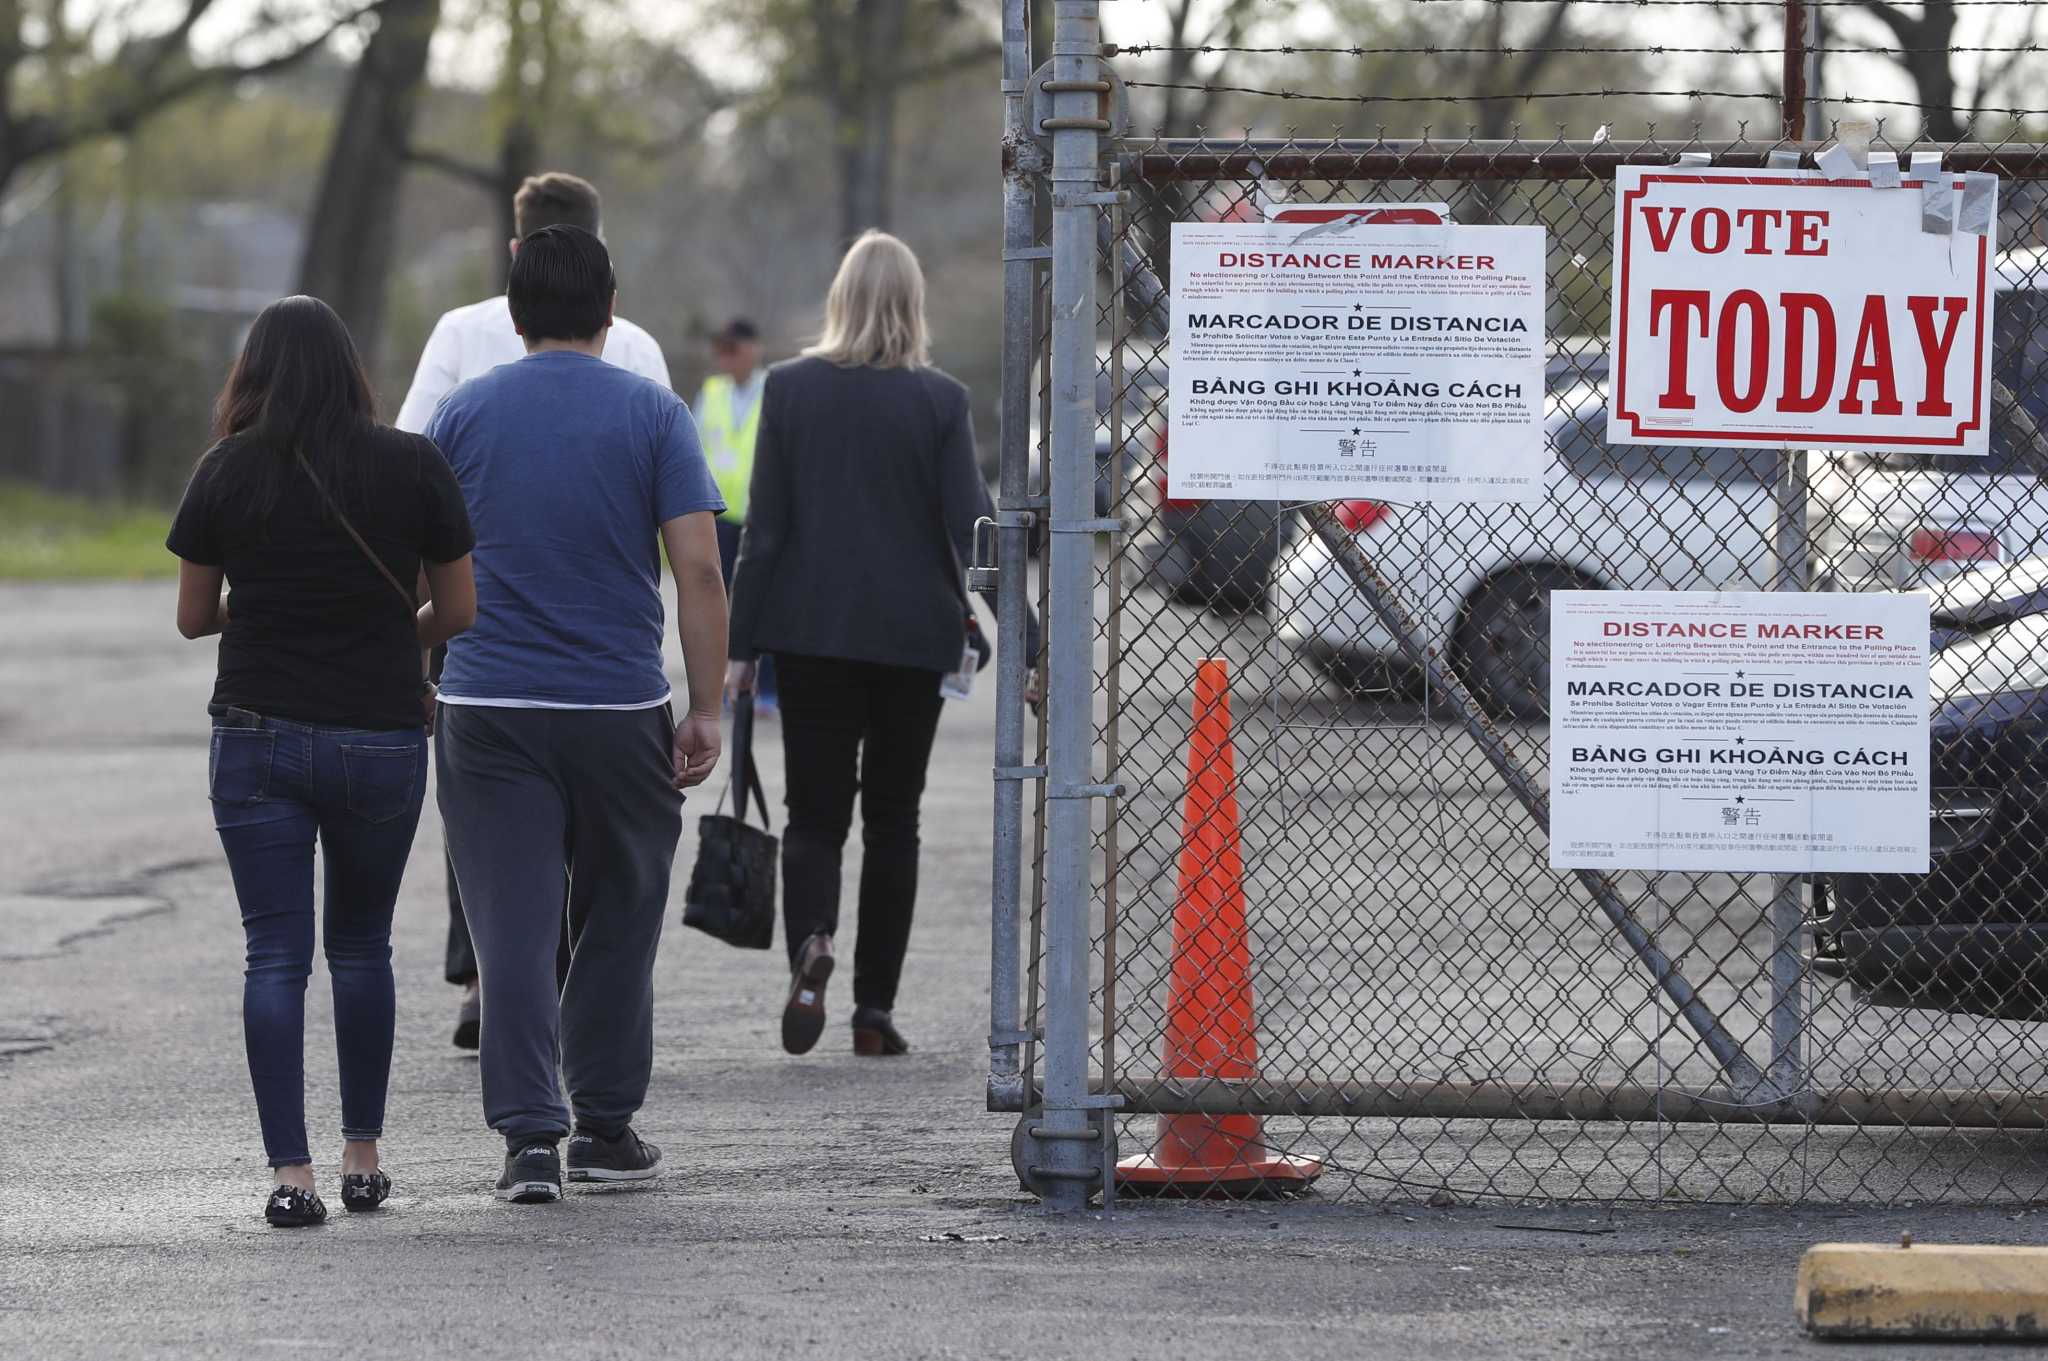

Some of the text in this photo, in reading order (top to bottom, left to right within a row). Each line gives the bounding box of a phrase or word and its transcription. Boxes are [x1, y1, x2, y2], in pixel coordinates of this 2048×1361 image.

[1639, 206, 1830, 256] VOTE
[1219, 253, 1494, 269] DISTANCE MARKER
[1188, 314, 1527, 331] MARCADOR DE DISTANCIA
[1649, 289, 1968, 417] TODAY
[1192, 376, 1521, 397] BẢNG GHI KHOẢNG CÁCH
[1337, 439, 1377, 457] 警告
[1603, 622, 1883, 639] DISTANCE MARKER
[1567, 681, 1913, 698] MARCADOR DE DISTANCIA
[1572, 744, 1907, 765] BẢNG GHI KHOẢNG CÁCH
[1721, 807, 1761, 826] 警告
[526, 1147, 550, 1155] adidas
